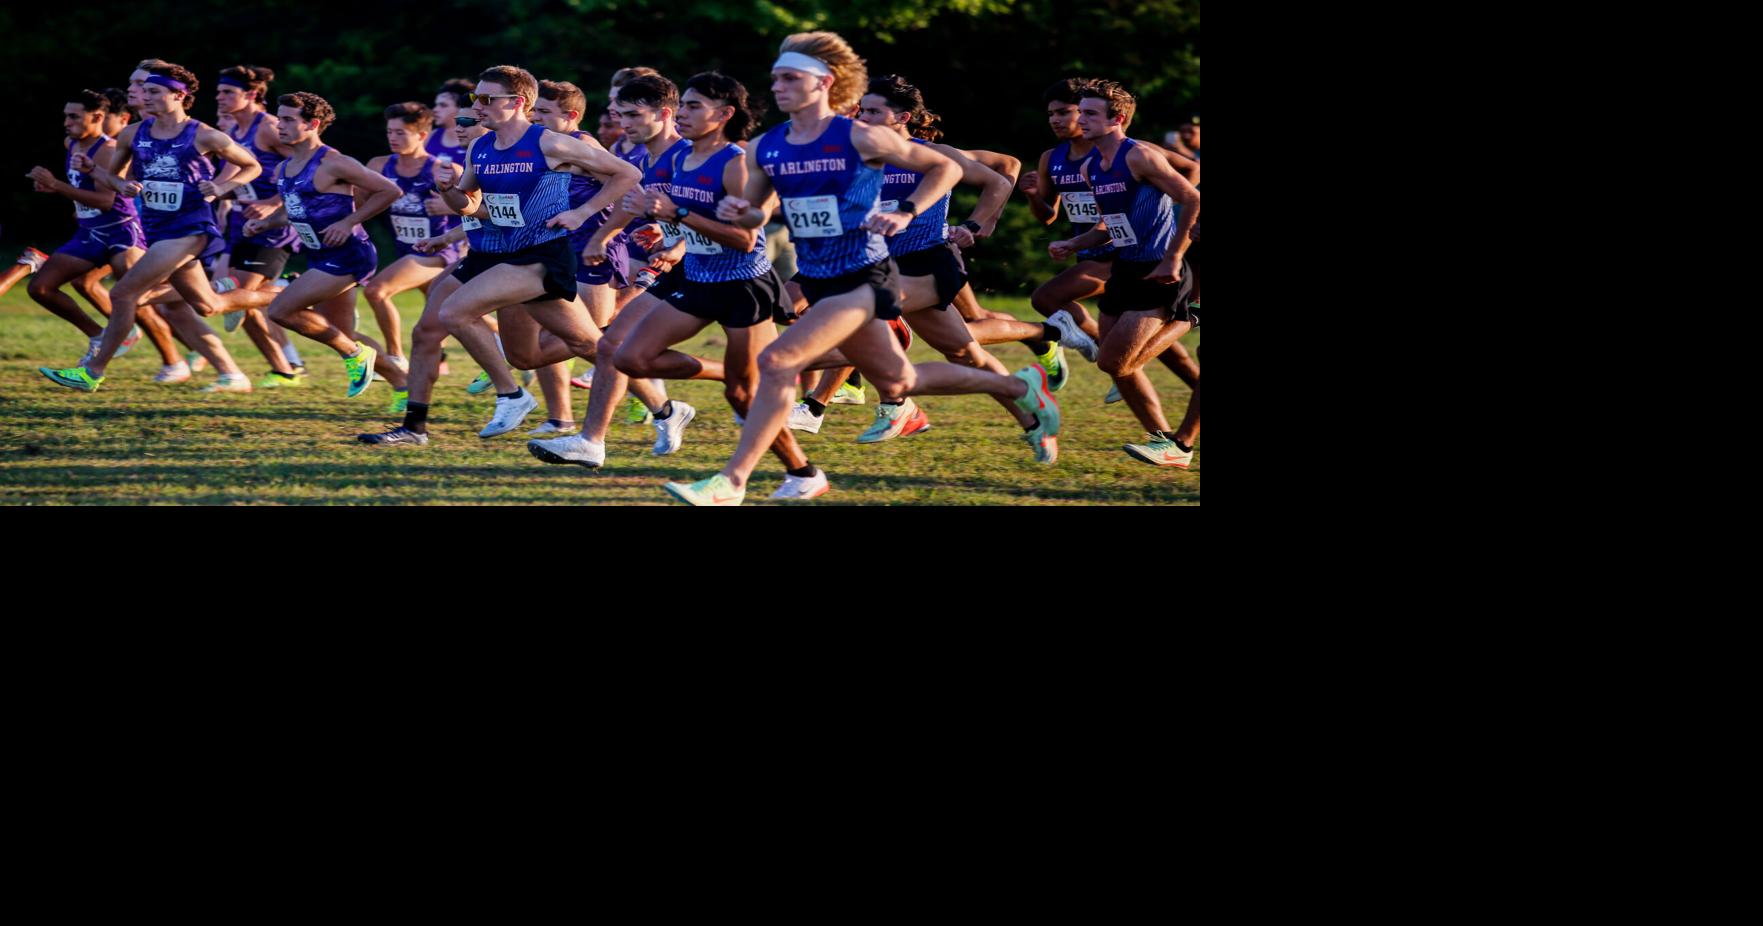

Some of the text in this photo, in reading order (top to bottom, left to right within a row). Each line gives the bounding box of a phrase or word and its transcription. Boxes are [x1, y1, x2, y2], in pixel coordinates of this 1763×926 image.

[483, 162, 534, 175] ARLINGTON
[780, 158, 846, 176] ARLINGTON
[882, 173, 916, 184] NGTON
[145, 190, 177, 204] 2110
[671, 184, 715, 204] ARLINGTON
[489, 205, 517, 220] 2144
[1067, 203, 1098, 216] 2145
[791, 210, 832, 228] 2142
[660, 221, 681, 239] 148
[1109, 225, 1129, 240] 151
